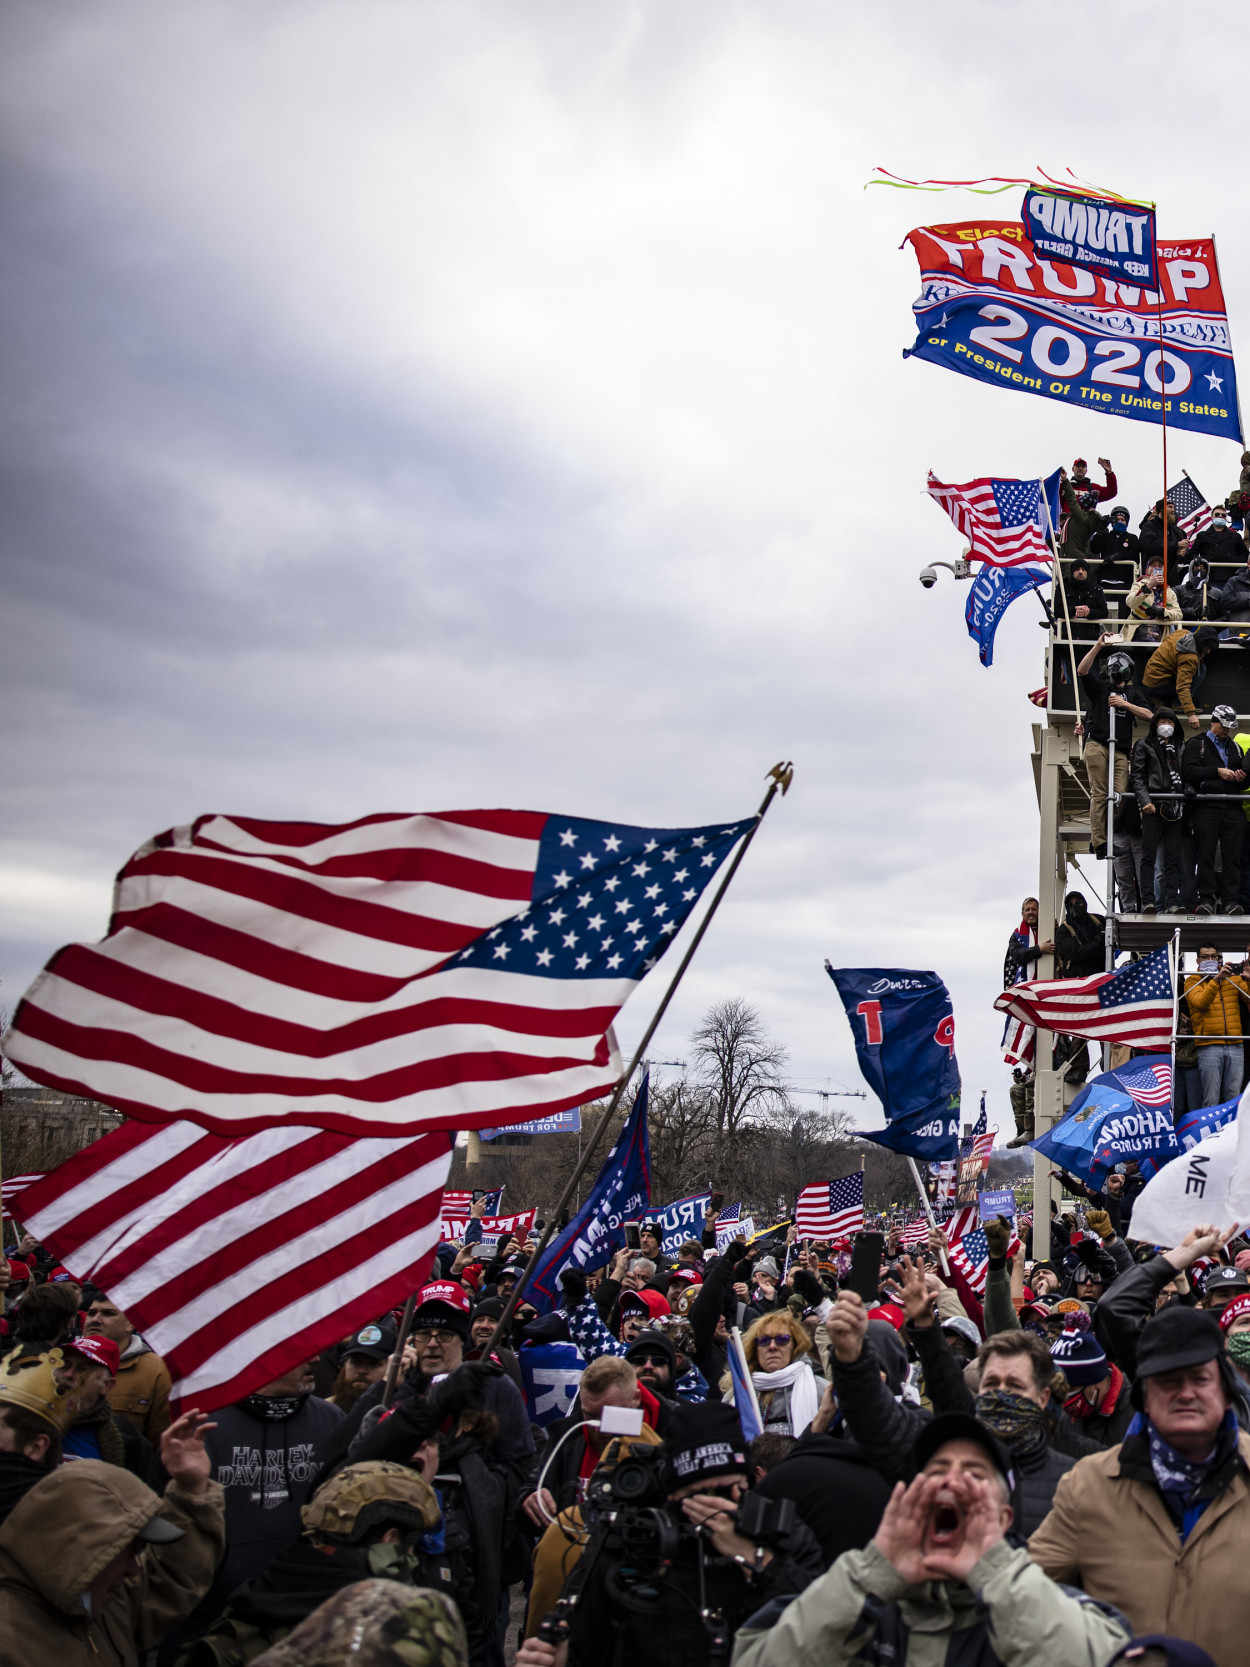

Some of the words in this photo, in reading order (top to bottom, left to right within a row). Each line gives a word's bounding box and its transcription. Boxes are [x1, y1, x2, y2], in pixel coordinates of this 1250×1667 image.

[917, 228, 1211, 305] TRUMP
[969, 304, 1192, 395] 2020
[927, 336, 949, 348] or
[954, 342, 1042, 390] President
[1049, 381, 1071, 396] Of
[1080, 386, 1113, 402] The
[1120, 393, 1172, 412] United
[1179, 401, 1228, 418] States
[422, 1284, 455, 1298] TRUMP
[694, 1442, 734, 1460] AMERICA
[702, 1453, 730, 1469] AGAIN
